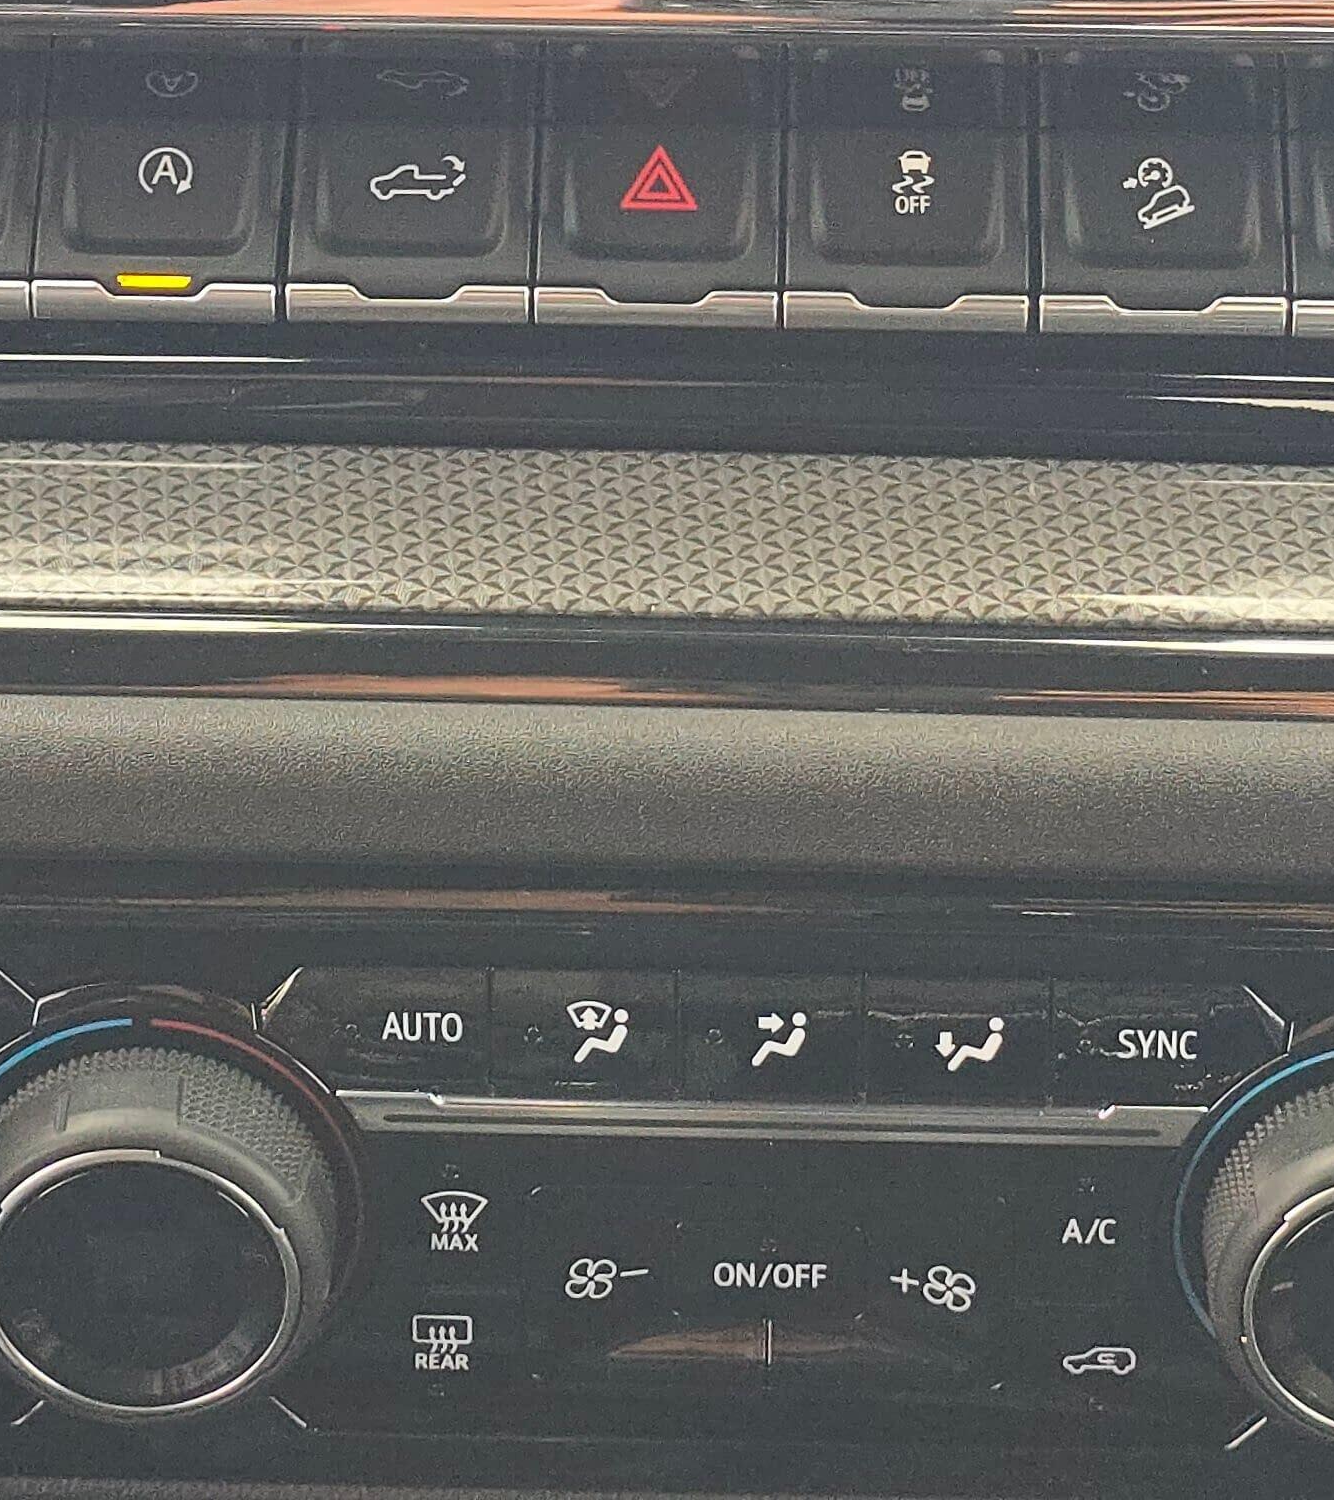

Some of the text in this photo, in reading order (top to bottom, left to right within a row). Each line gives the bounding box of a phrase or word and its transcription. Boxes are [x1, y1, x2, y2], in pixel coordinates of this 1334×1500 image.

[151, 154, 179, 186] A
[894, 195, 931, 215] OFF
[381, 1011, 464, 1042] AUTO
[1117, 1028, 1199, 1060] SYNC
[430, 1233, 479, 1252] MAX
[1061, 1217, 1118, 1245] A/C
[712, 1261, 828, 1289] ON/OFF
[414, 1352, 470, 1371] REAR
